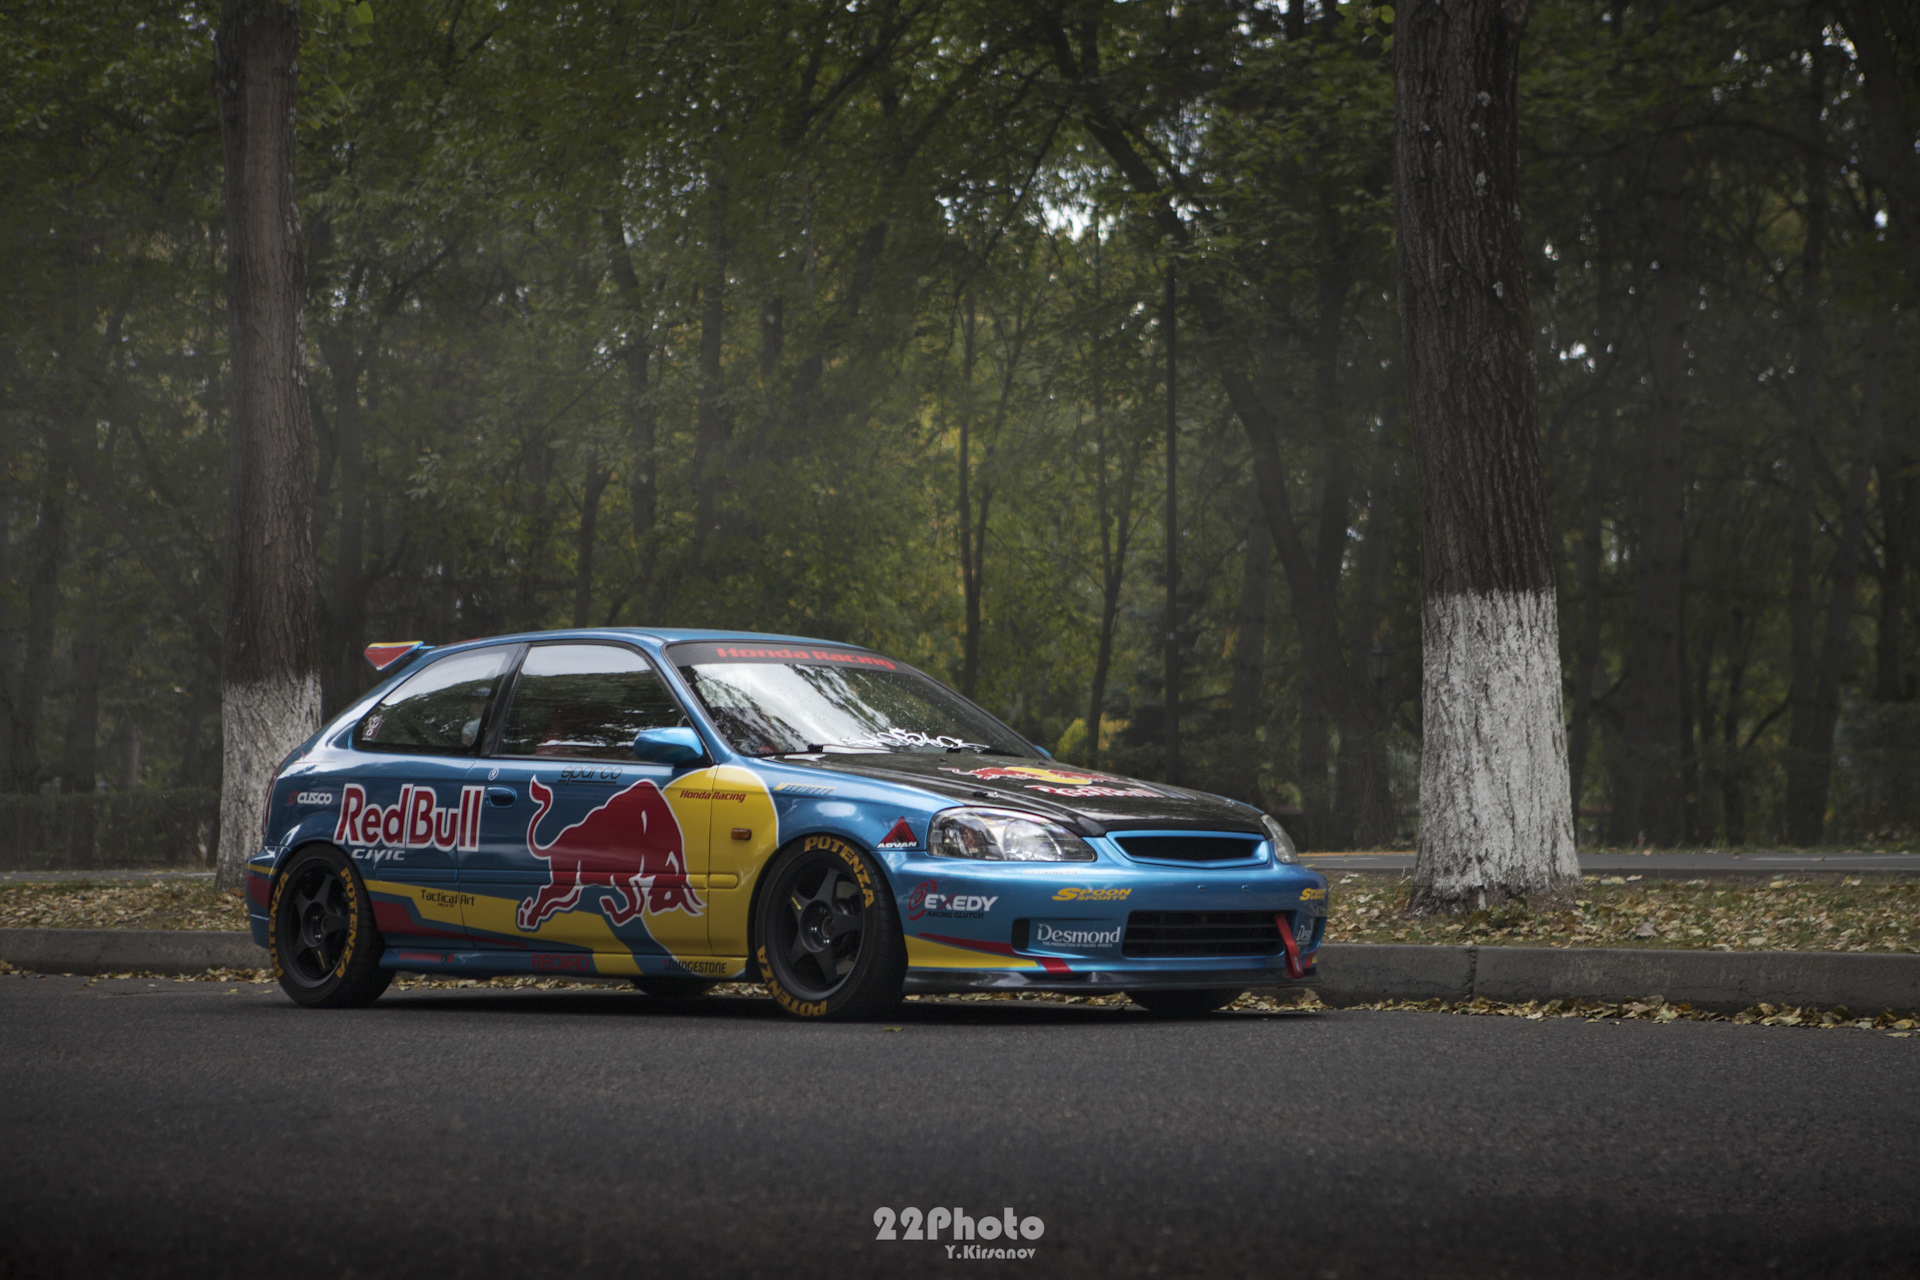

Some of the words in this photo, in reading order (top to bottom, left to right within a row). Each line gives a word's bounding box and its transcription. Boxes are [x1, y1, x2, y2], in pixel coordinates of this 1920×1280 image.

[716, 648, 810, 659] Honda
[811, 650, 897, 670] Racing
[560, 765, 623, 785] sparco
[679, 790, 711, 800] Honda
[712, 791, 746, 803] Racing
[876, 841, 917, 849] ADVAN
[804, 836, 874, 908] POTENZA
[420, 889, 458, 905] Tactical
[460, 892, 475, 906] Art
[924, 894, 999, 912] EXEDY
[1052, 888, 1132, 901] SPOON
[335, 867, 358, 978] POTENZA
[927, 910, 952, 918] RACING
[954, 911, 984, 919] CLUTCH
[1037, 923, 1121, 943] Desmond
[531, 954, 589, 972] RECARO
[757, 945, 827, 1016] POTENZA
